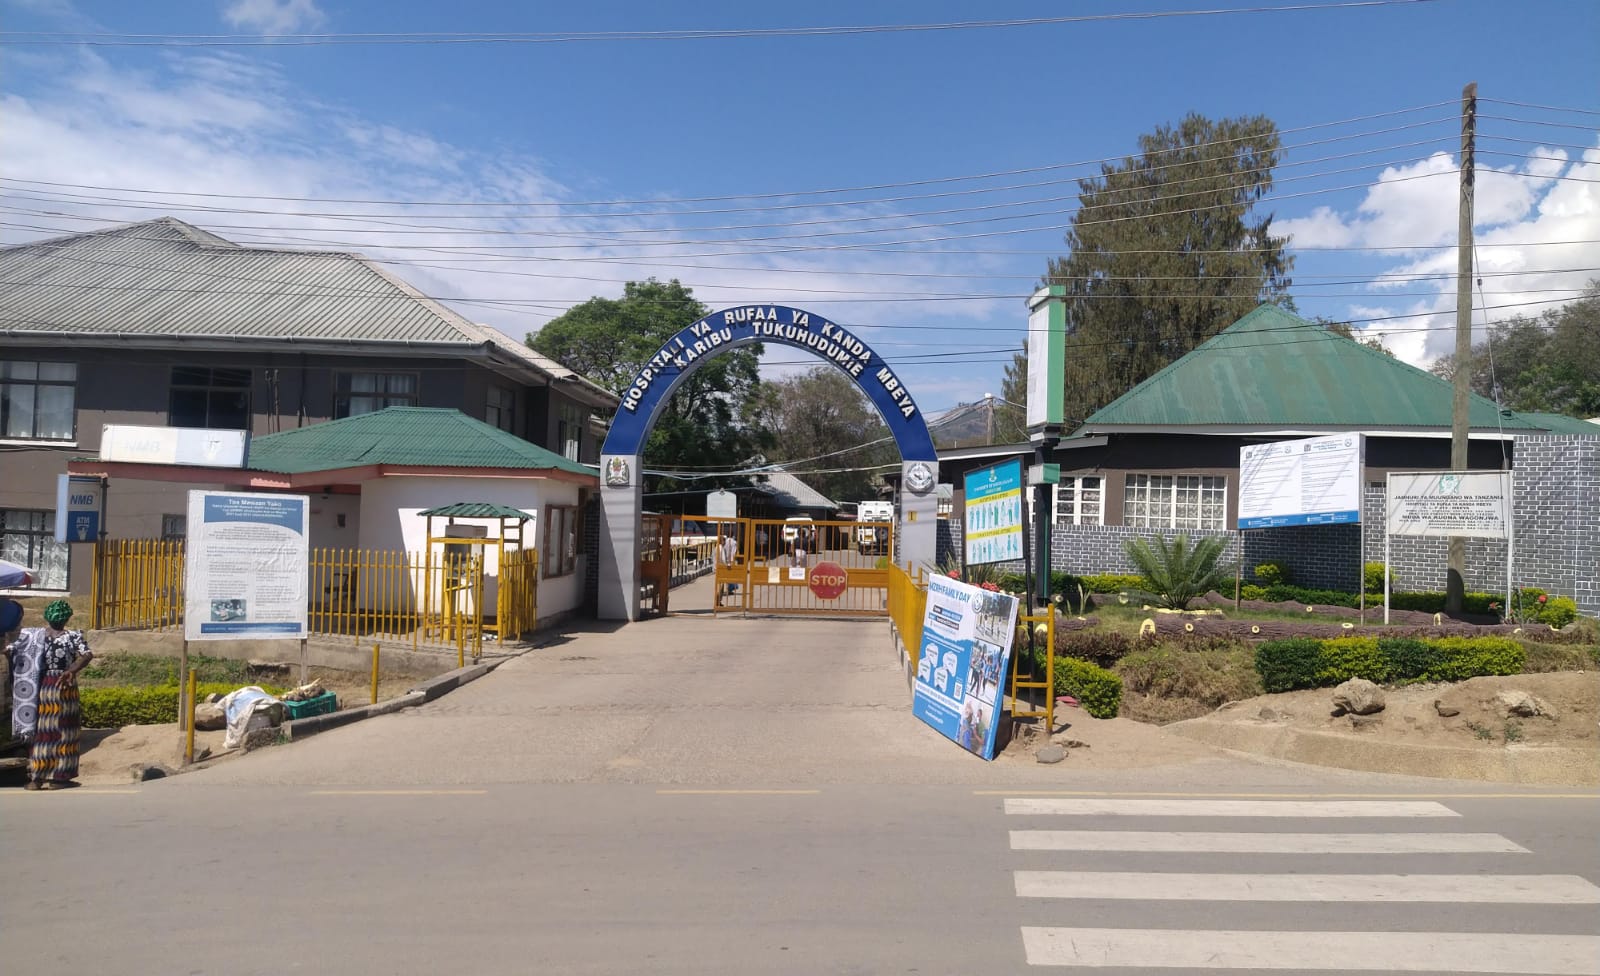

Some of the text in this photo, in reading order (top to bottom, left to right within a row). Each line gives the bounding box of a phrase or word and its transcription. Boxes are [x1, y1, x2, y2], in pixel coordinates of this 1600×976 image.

[623, 307, 916, 418] HOSPITALI YA RUFAA YA KANDA MBEYA
[674, 321, 863, 377] KARIBU TUKUHUDUMIE
[70, 494, 93, 505] NMB
[811, 576, 845, 586] STOP
